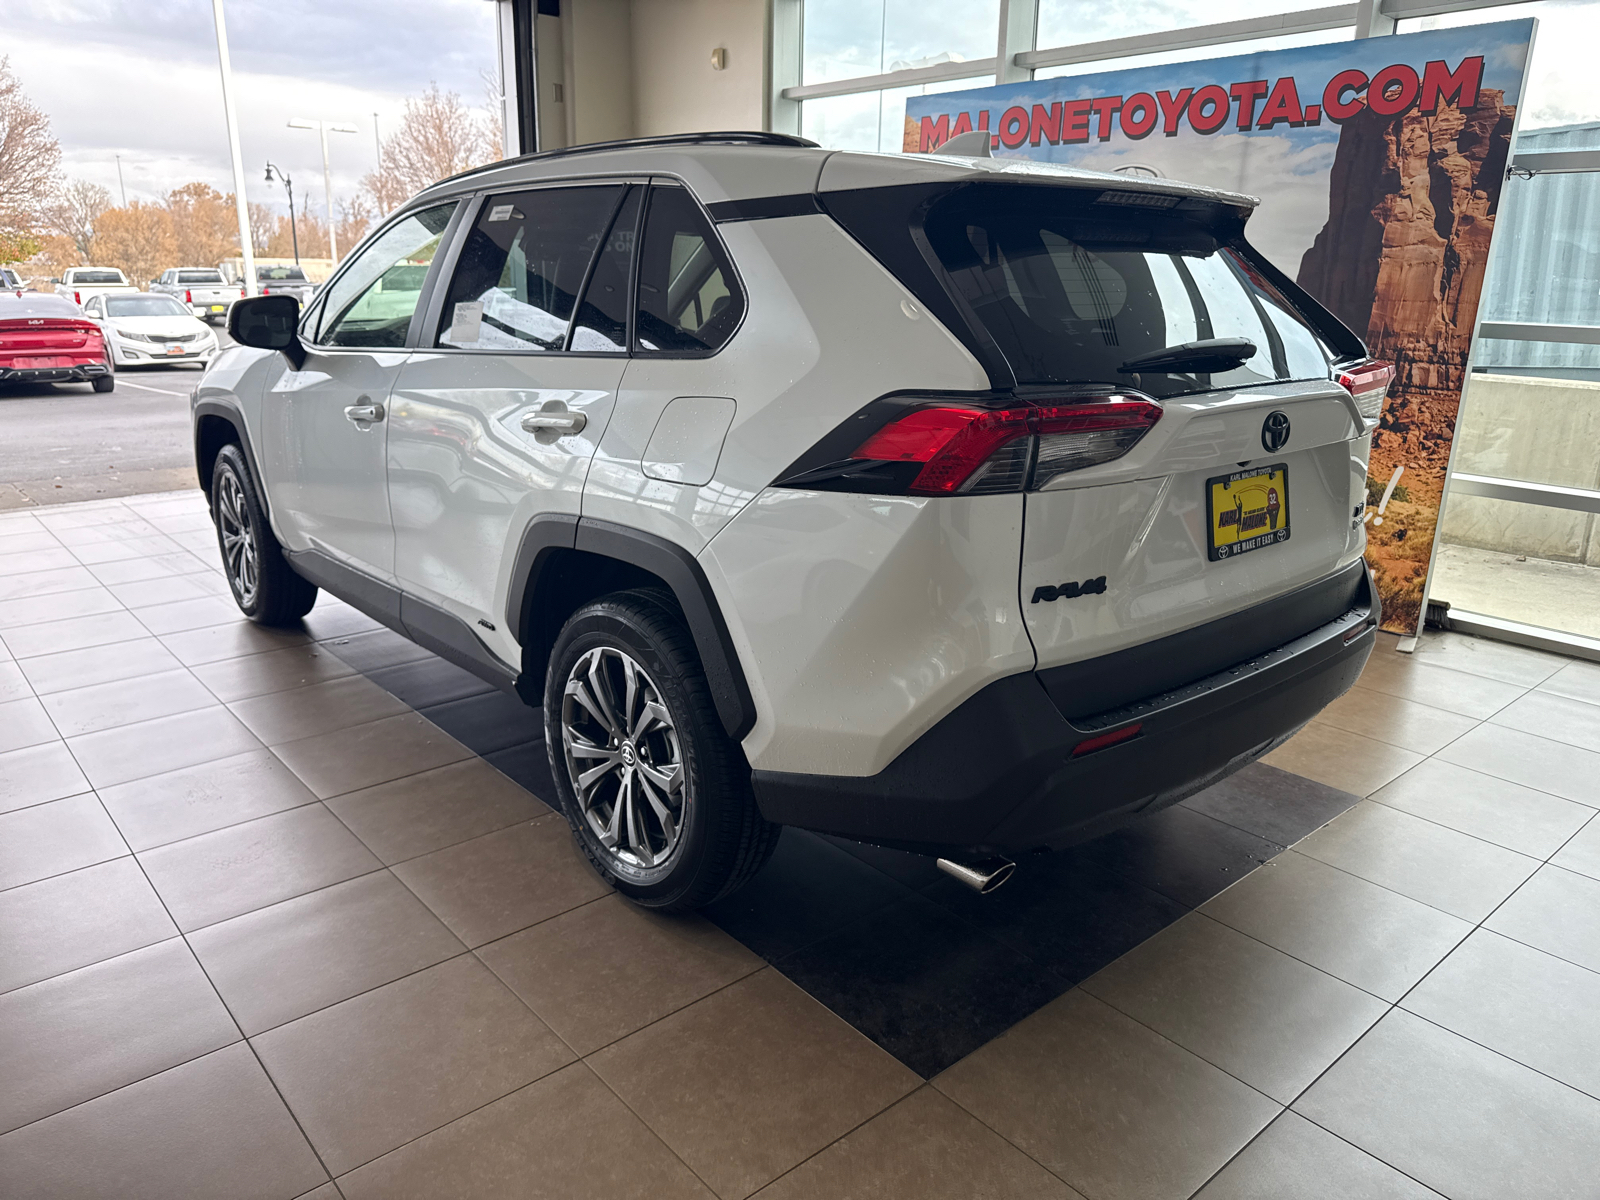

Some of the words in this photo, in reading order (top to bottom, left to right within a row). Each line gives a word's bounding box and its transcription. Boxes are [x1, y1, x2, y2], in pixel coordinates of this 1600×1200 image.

[918, 55, 1486, 154] MALONETOYOTA.COM
[1242, 470, 1257, 479] MALONE
[1269, 493, 1276, 504] 32
[1218, 509, 1238, 528] KARL
[1241, 511, 1268, 532] MALONE
[1233, 544, 1241, 554] WE
[1242, 540, 1256, 550] MAKE
[1256, 538, 1261, 547] IT
[1262, 534, 1274, 545] EASY
[1030, 575, 1107, 604] RAV4
